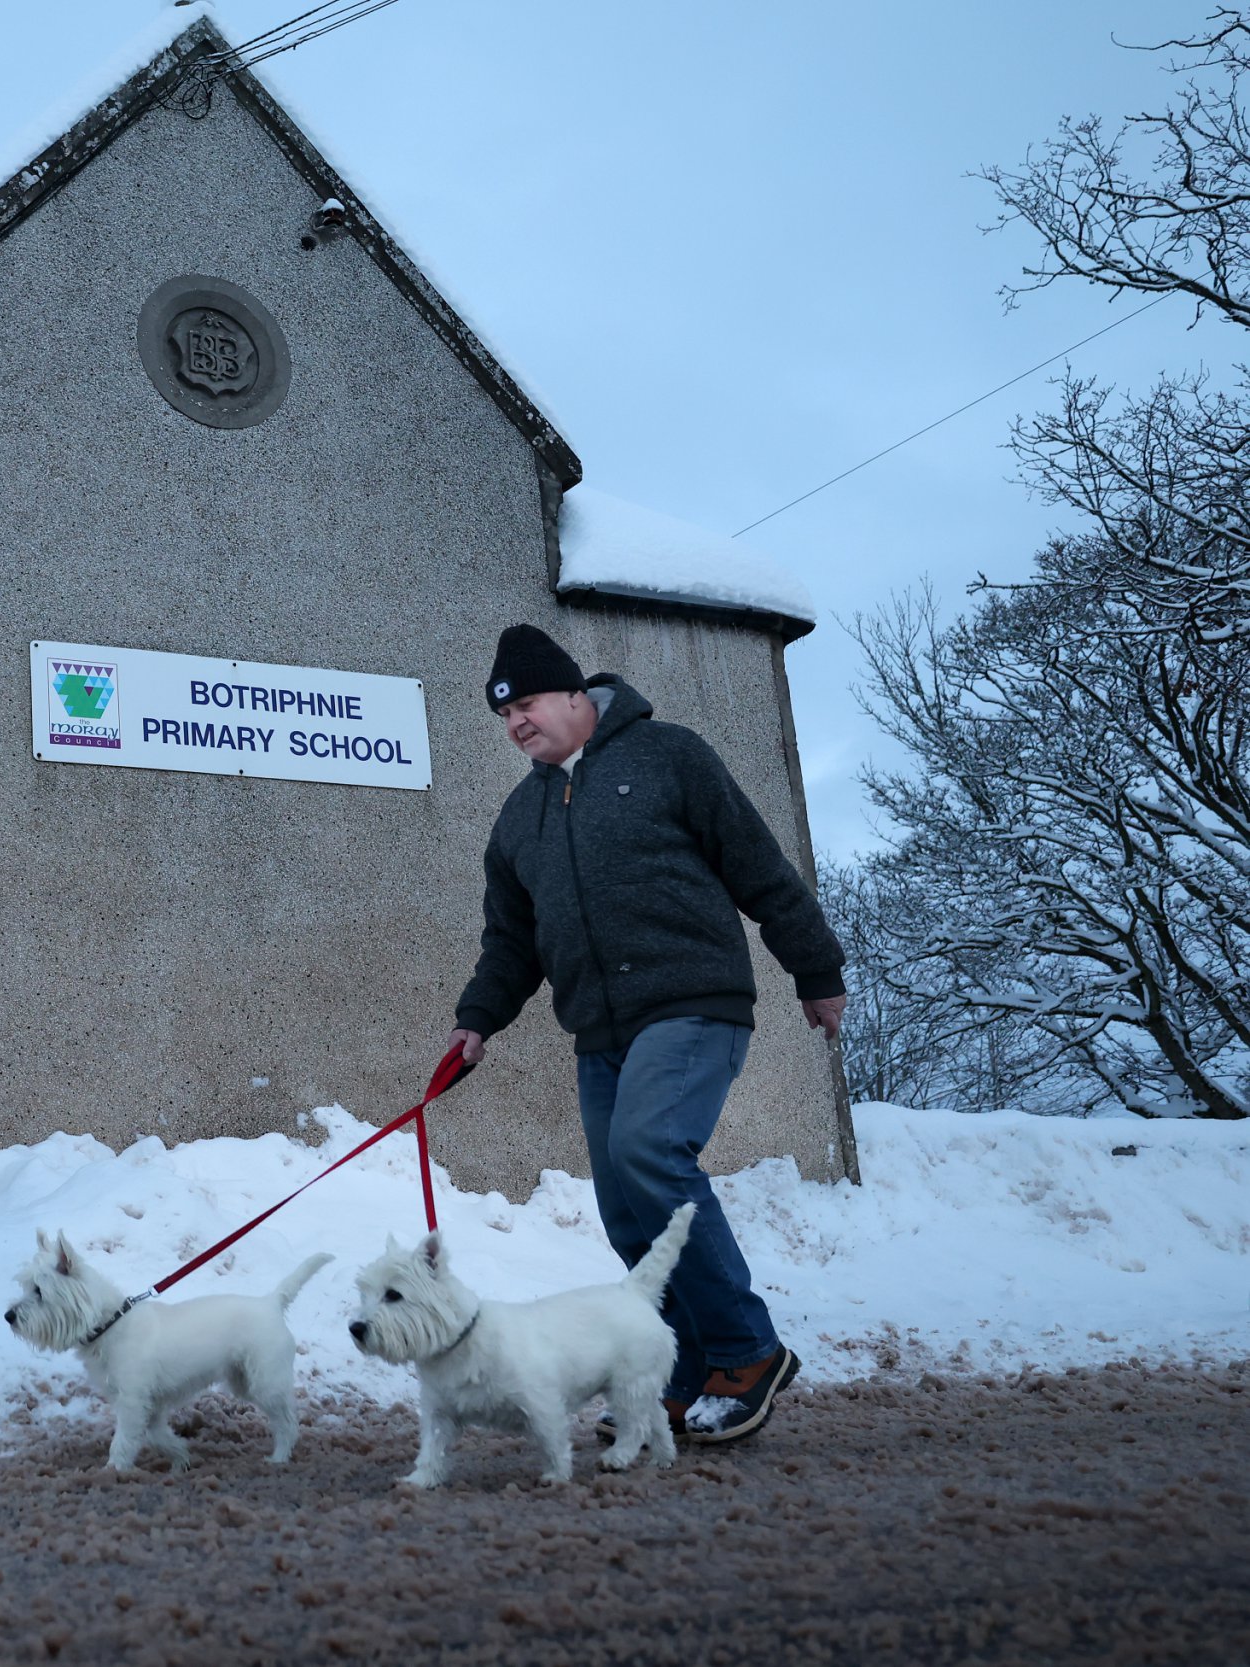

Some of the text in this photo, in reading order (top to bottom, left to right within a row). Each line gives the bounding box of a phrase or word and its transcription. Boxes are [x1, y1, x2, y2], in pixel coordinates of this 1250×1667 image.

[190, 680, 363, 720] BOTRIPHNIE
[53, 735, 118, 747] Council
[142, 717, 412, 765] PRIMARY SCHOOL
